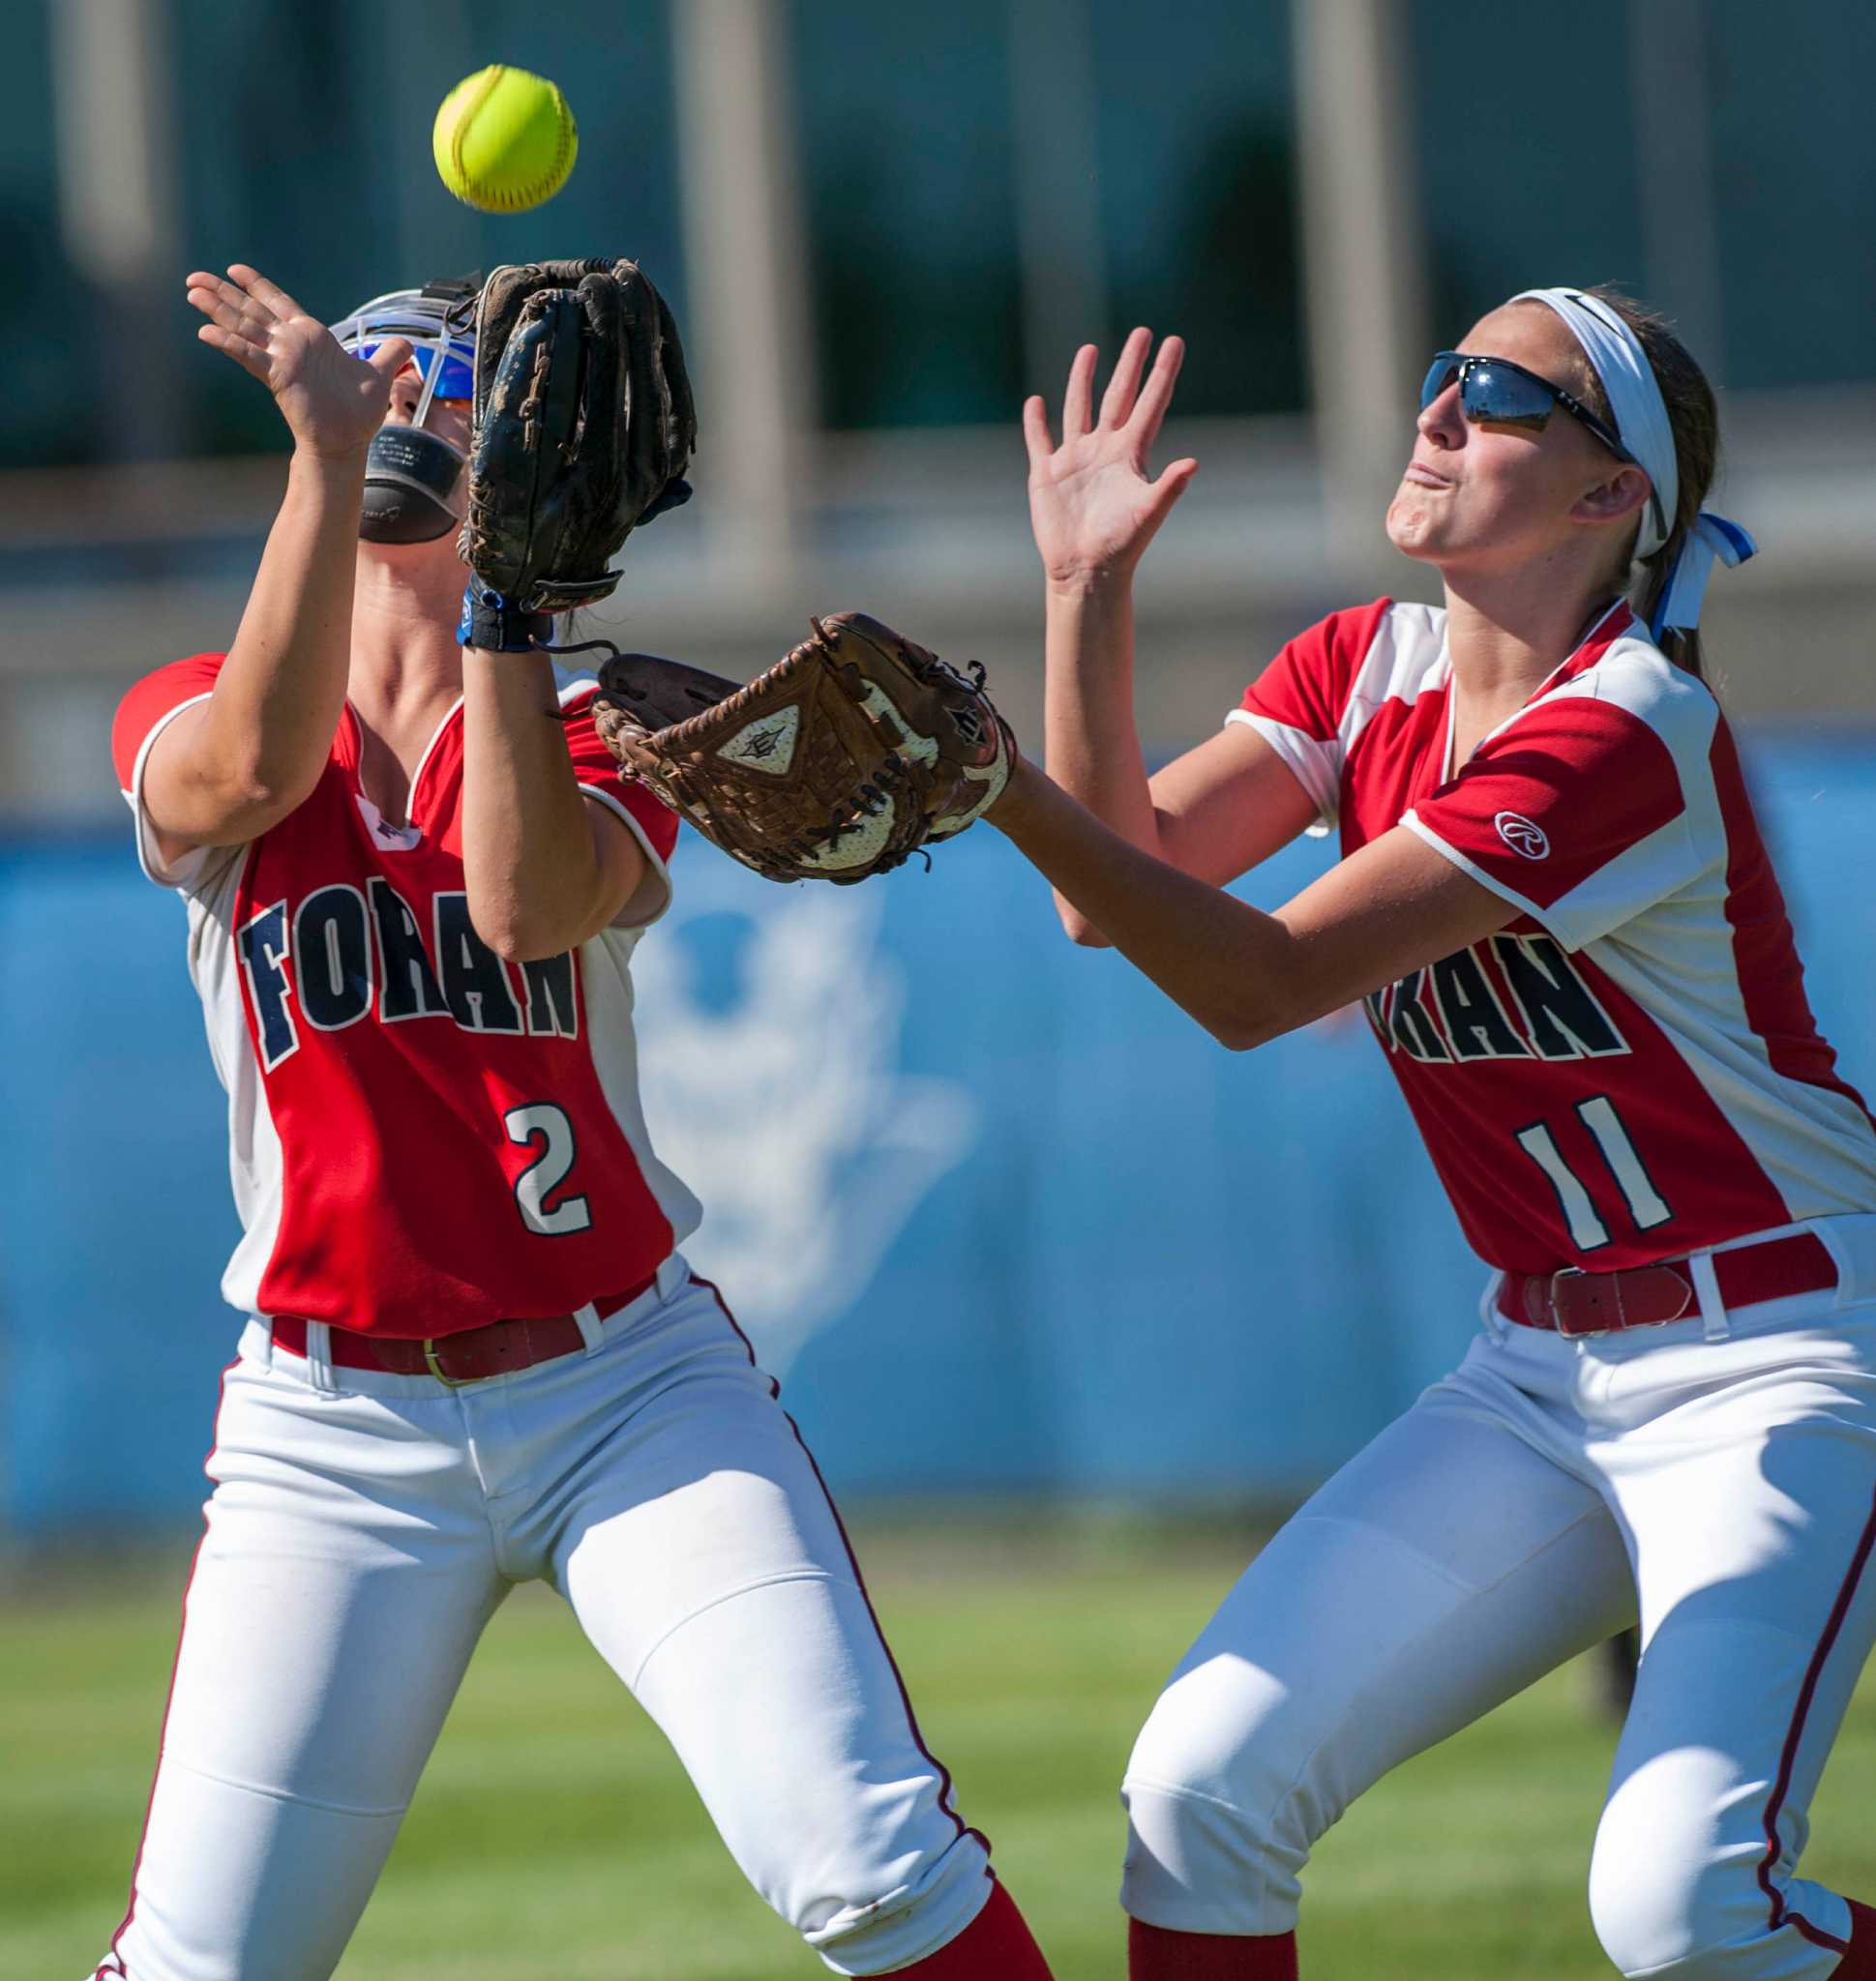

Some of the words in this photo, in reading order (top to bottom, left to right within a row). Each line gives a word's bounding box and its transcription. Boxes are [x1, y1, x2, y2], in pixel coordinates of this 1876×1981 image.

[237, 876, 579, 1075] FORAN
[1361, 931, 1633, 1063] RAN
[504, 1101, 592, 1236] 2
[1513, 1094, 1675, 1252] 11
